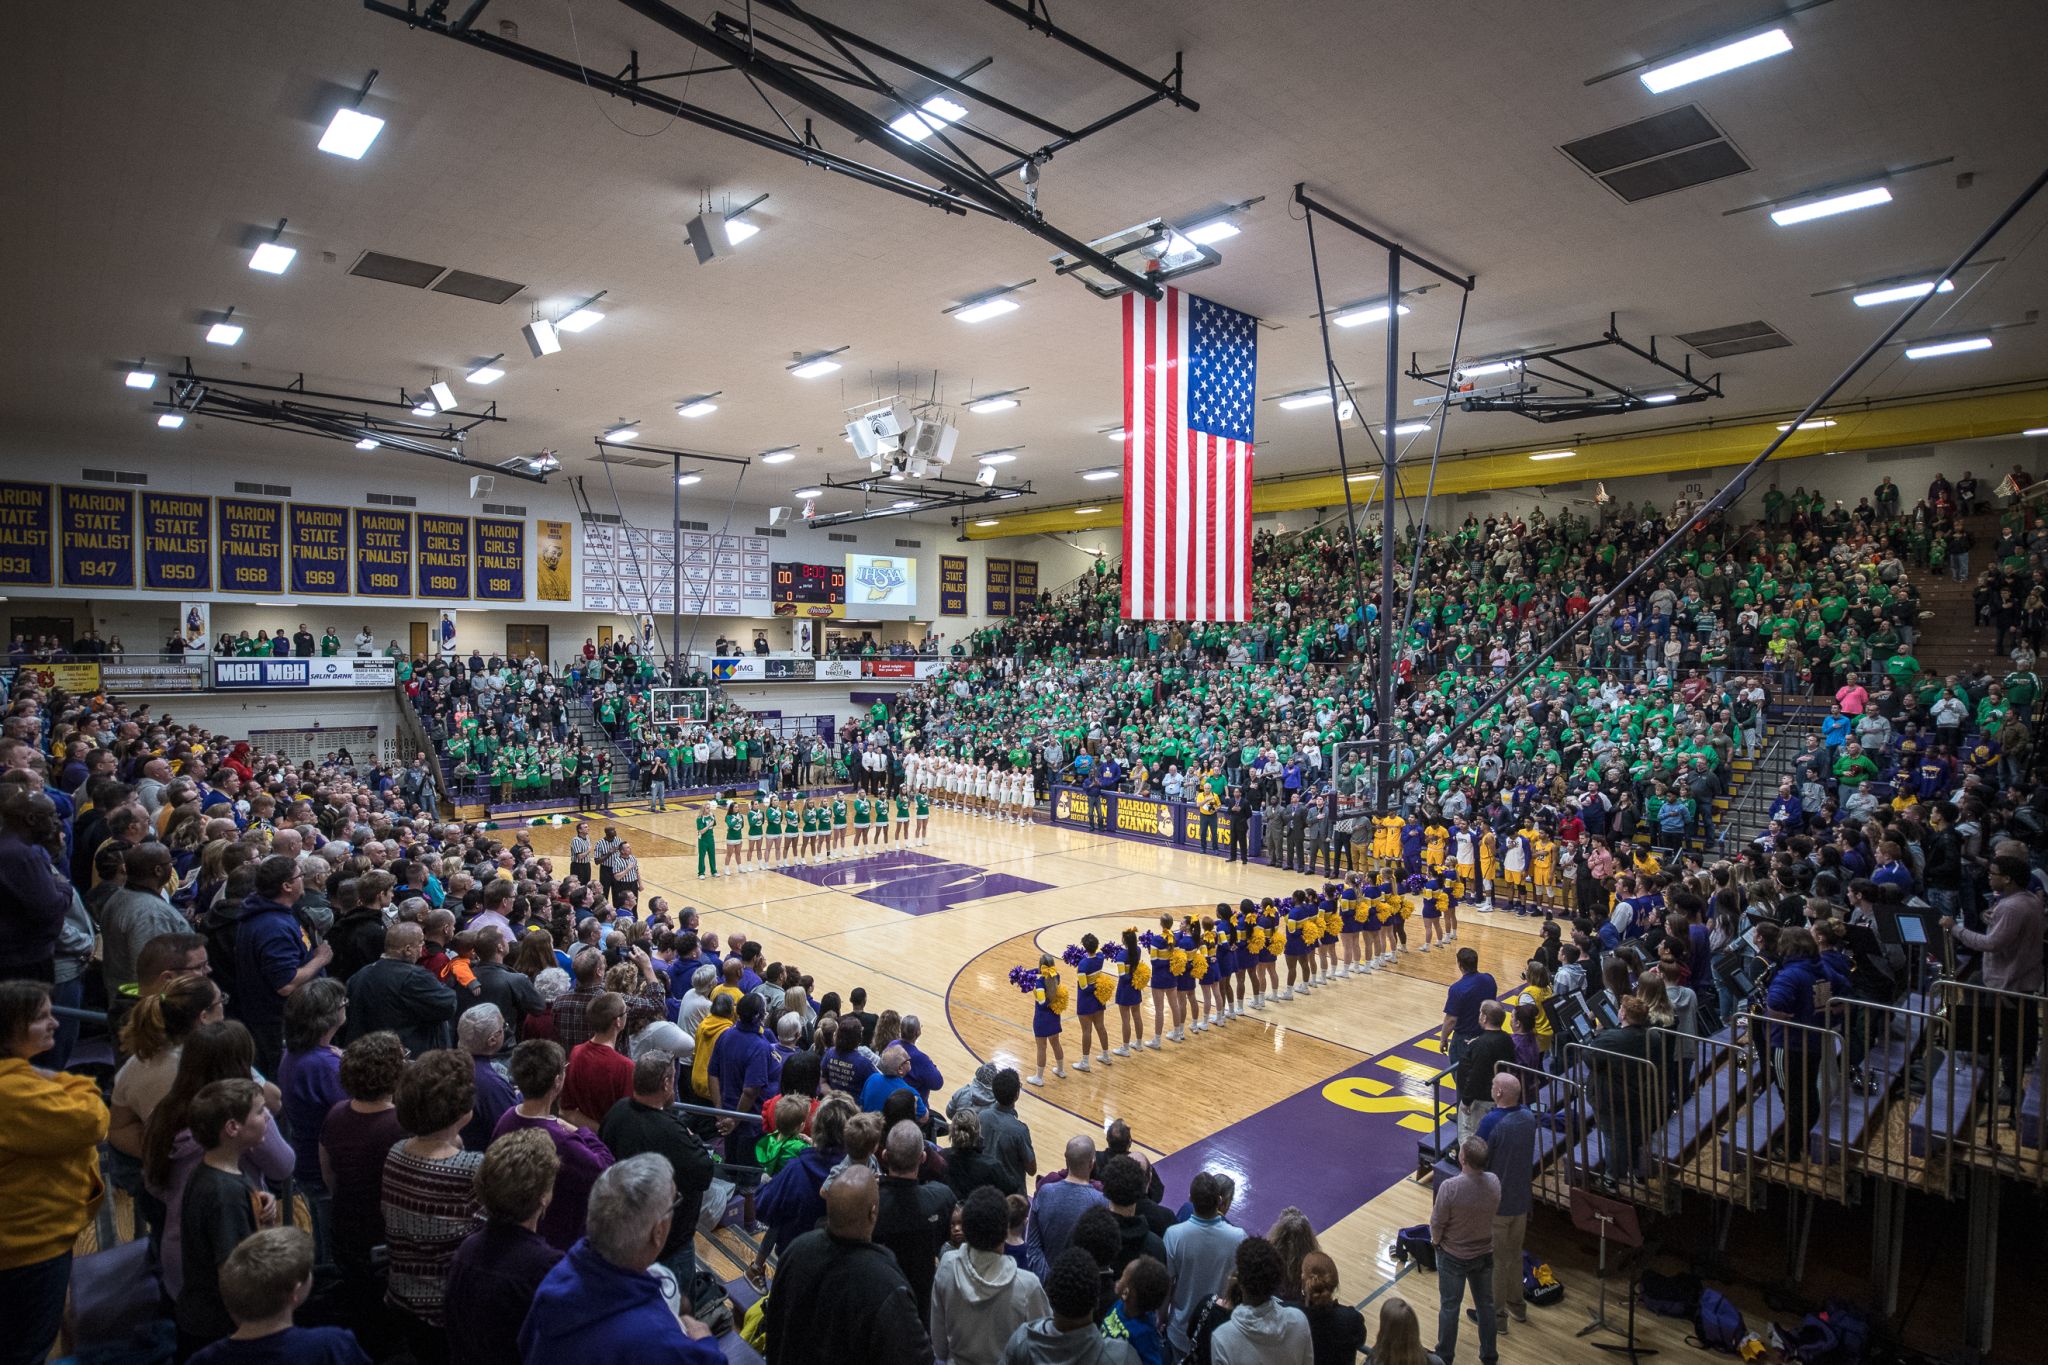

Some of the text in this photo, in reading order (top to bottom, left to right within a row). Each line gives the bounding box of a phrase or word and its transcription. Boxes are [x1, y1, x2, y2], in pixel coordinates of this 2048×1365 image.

[69, 493, 125, 512] MARION
[151, 499, 203, 517] MARION
[226, 504, 275, 522] MARION
[296, 510, 342, 527] MARION
[74, 513, 121, 531] STATE
[155, 519, 199, 536] STATE
[362, 515, 405, 532] MARION
[423, 520, 463, 535] MARION
[231, 523, 271, 540] STATE
[300, 528, 338, 544] STATE
[480, 524, 519, 539] MARION
[64, 532, 130, 550] FINALIST
[146, 536, 207, 554] FINALIST
[366, 533, 401, 548] STATE
[427, 536, 460, 551] GIRLS
[484, 539, 515, 554] GIRLS
[222, 541, 279, 557] FINALIST
[292, 546, 346, 561] FINALIST
[359, 548, 408, 564] FINALIST
[419, 552, 468, 567] FINALIST
[478, 554, 521, 570] FINALIST
[944, 560, 964, 570] MARION
[80, 560, 117, 576] 1947
[161, 564, 195, 580] 1950
[235, 567, 268, 583] 1968
[990, 563, 1009, 572] MARION
[305, 570, 335, 585] 1969
[370, 573, 398, 587] 1980
[430, 576, 457, 590] 1980
[778, 571, 791, 583] 00
[831, 574, 844, 586] 00
[857, 567, 904, 587] IHSAA
[946, 572, 962, 581] STATE
[992, 574, 1007, 583] STATE
[1019, 576, 1034, 585] STATE
[489, 578, 511, 591] 1981
[942, 583, 966, 592] FINALIST
[787, 591, 792, 600] 0
[830, 593, 835, 602] 0
[218, 664, 260, 681] MGH
[266, 664, 306, 680] MGH
[737, 664, 753, 672] IMG
[1118, 798, 1158, 814] MARION
[1134, 811, 1157, 819] SCHOOL
[1117, 815, 1157, 834] GIANTS
